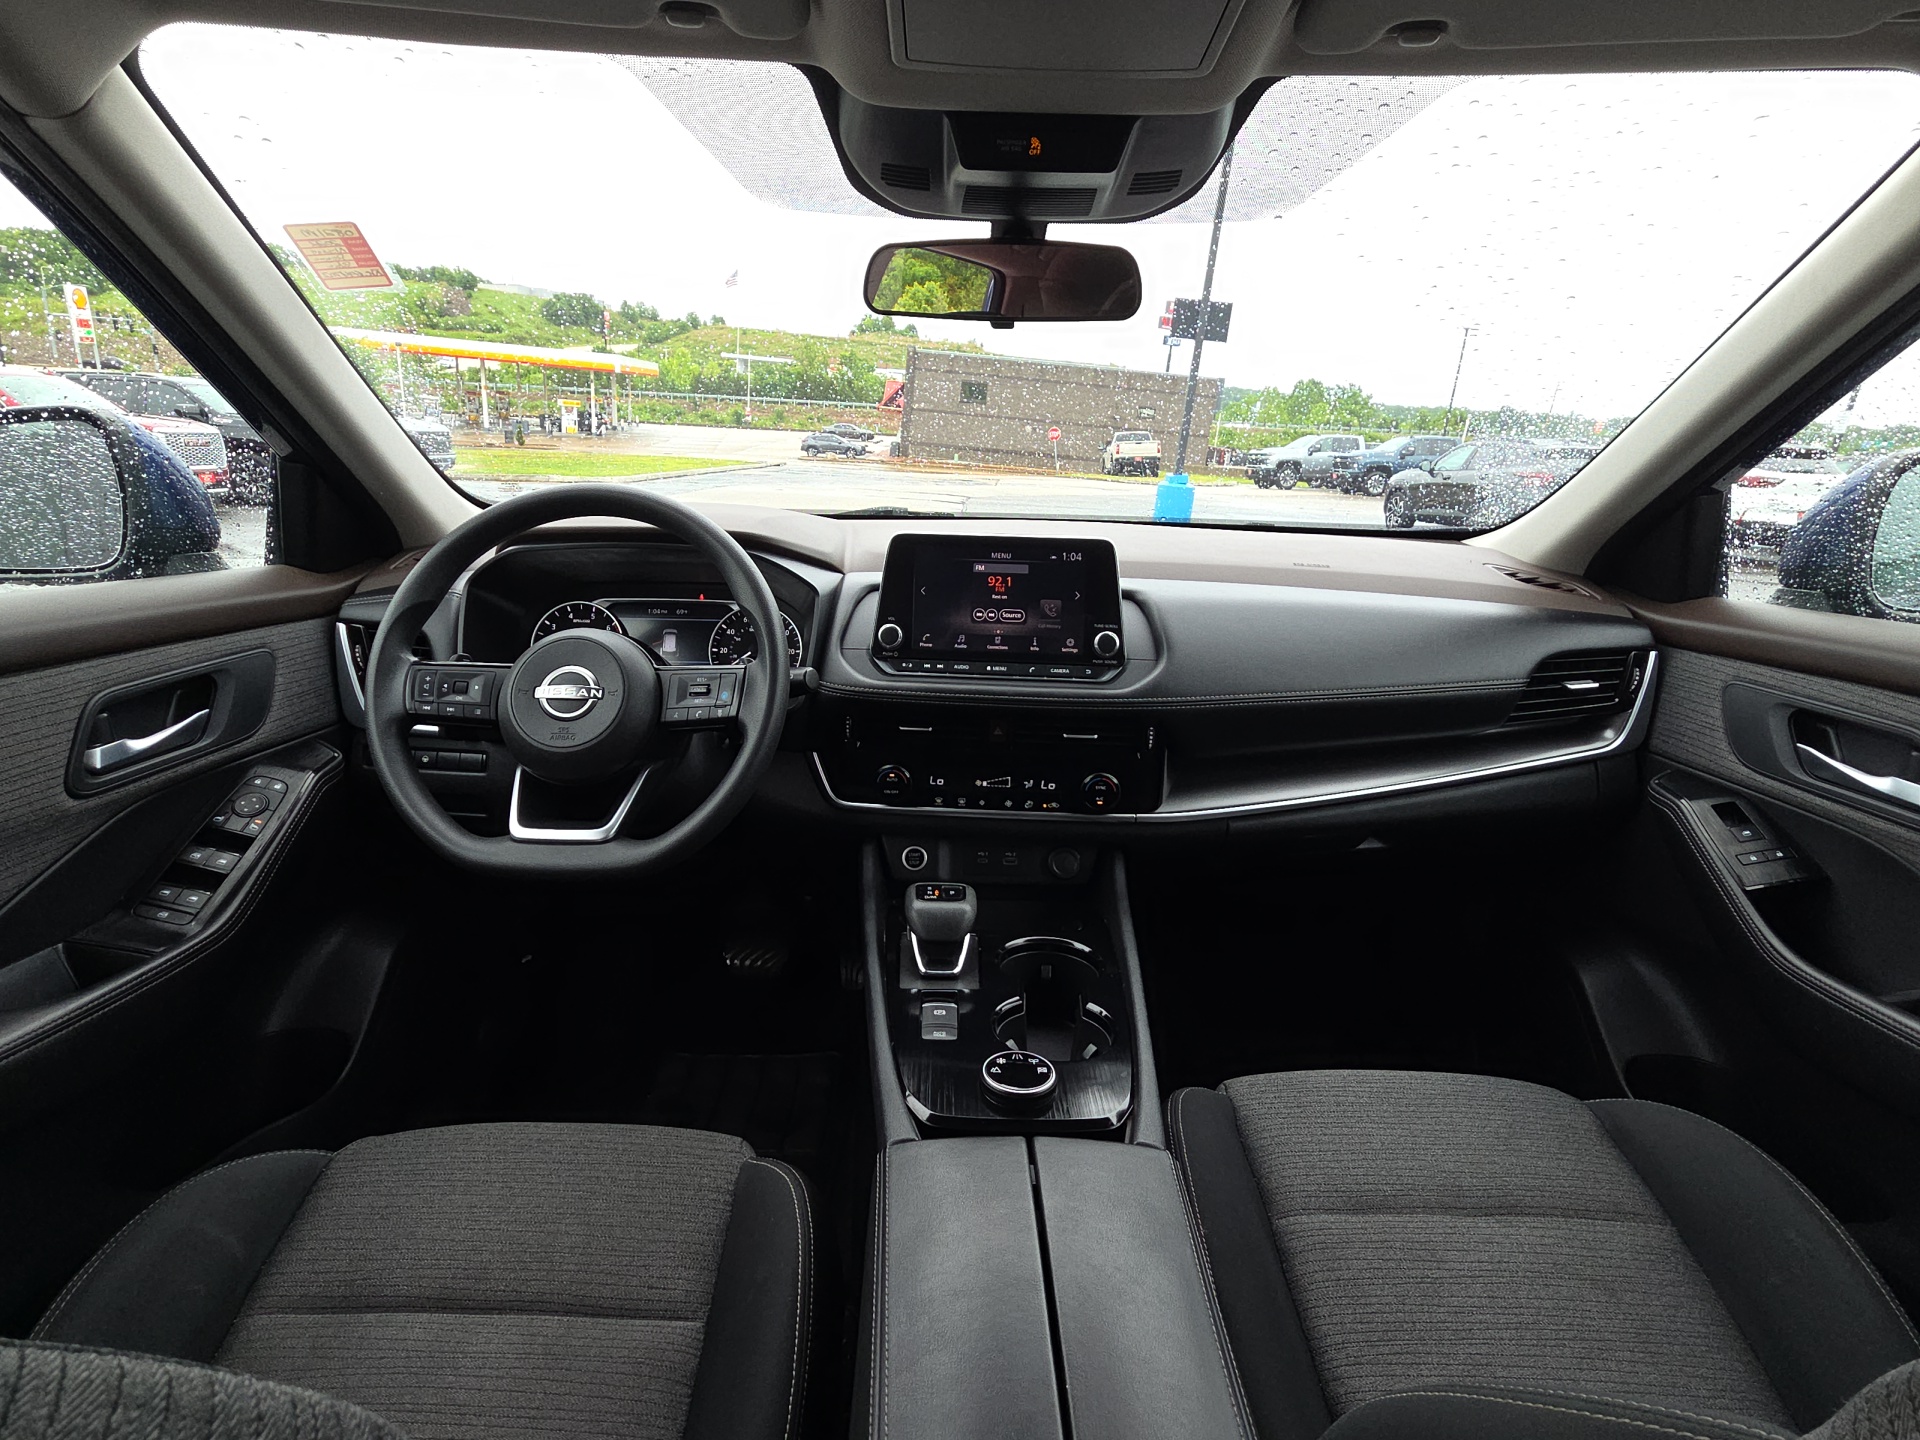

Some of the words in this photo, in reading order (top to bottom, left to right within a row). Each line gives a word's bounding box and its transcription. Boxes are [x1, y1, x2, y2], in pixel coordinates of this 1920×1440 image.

[1062, 552, 1082, 561] 1:04
[987, 575, 1012, 587] 92.1
[536, 687, 603, 698] NISSAN
[929, 775, 944, 786] Lo
[1040, 780, 1056, 790] Lo
